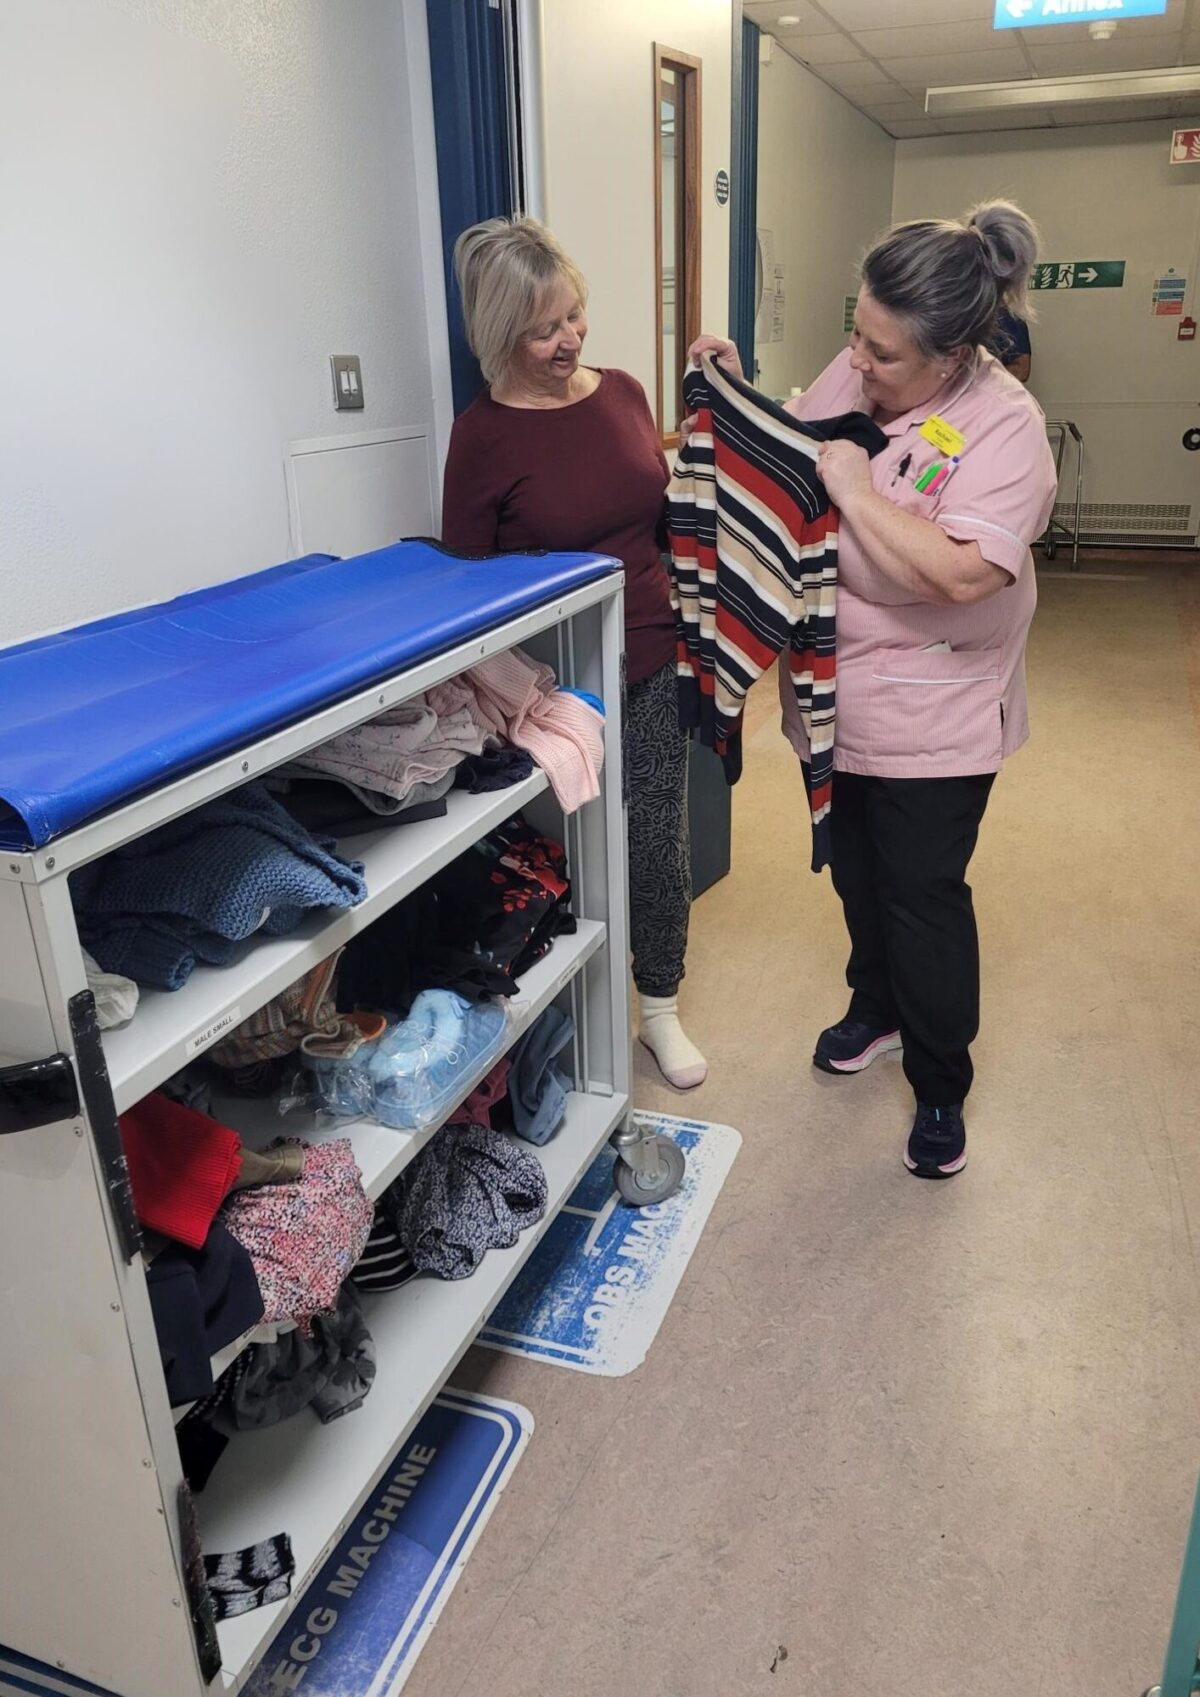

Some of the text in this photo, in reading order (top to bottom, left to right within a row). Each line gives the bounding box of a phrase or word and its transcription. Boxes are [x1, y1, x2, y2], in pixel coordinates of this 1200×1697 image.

[194, 1016, 232, 1047] MALE SMALL
[583, 1201, 670, 1329] OBS MAC
[269, 1606, 338, 1690] ECG
[326, 1443, 437, 1598] MACHINE
